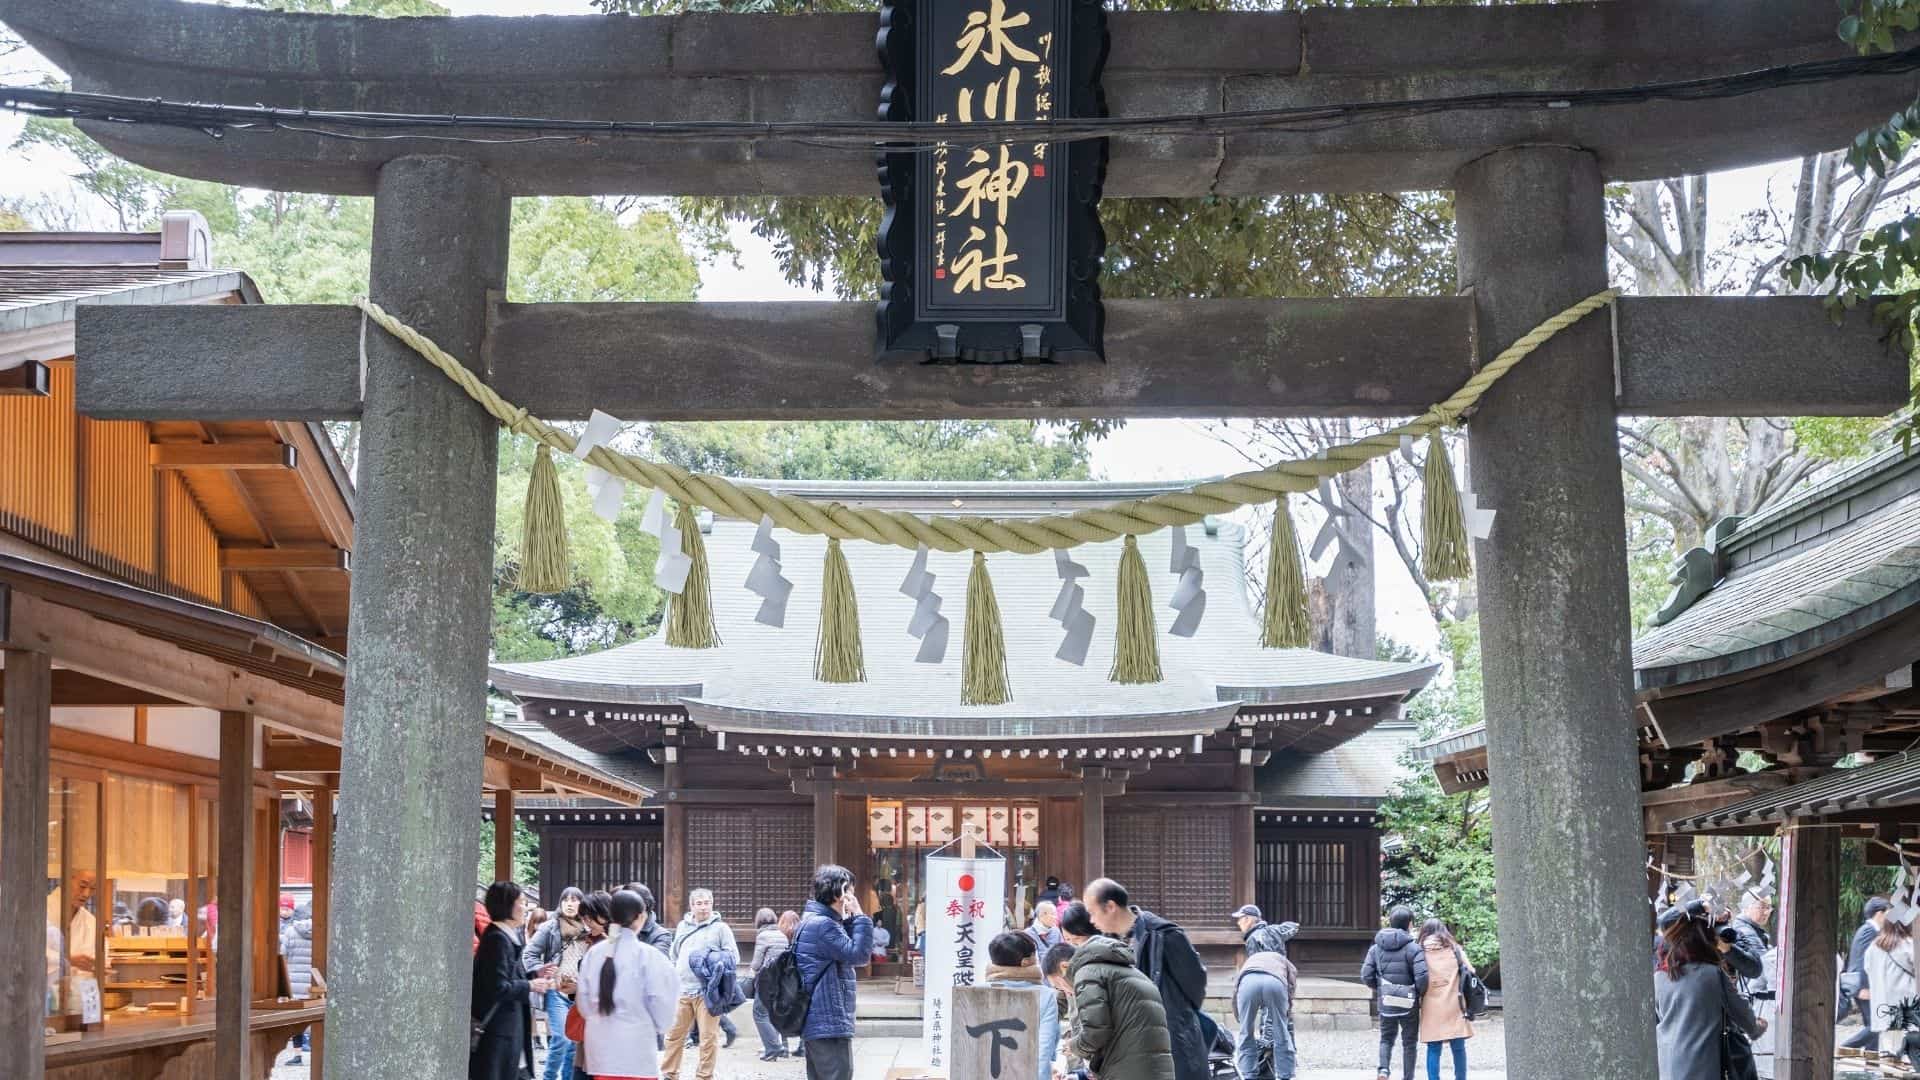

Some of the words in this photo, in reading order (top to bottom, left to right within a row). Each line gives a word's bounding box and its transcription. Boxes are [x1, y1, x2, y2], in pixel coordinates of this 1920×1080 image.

[941, 0, 1041, 294] 氷川神社
[945, 899, 985, 918] 奉祝
[966, 1017, 1027, 1079] 下
